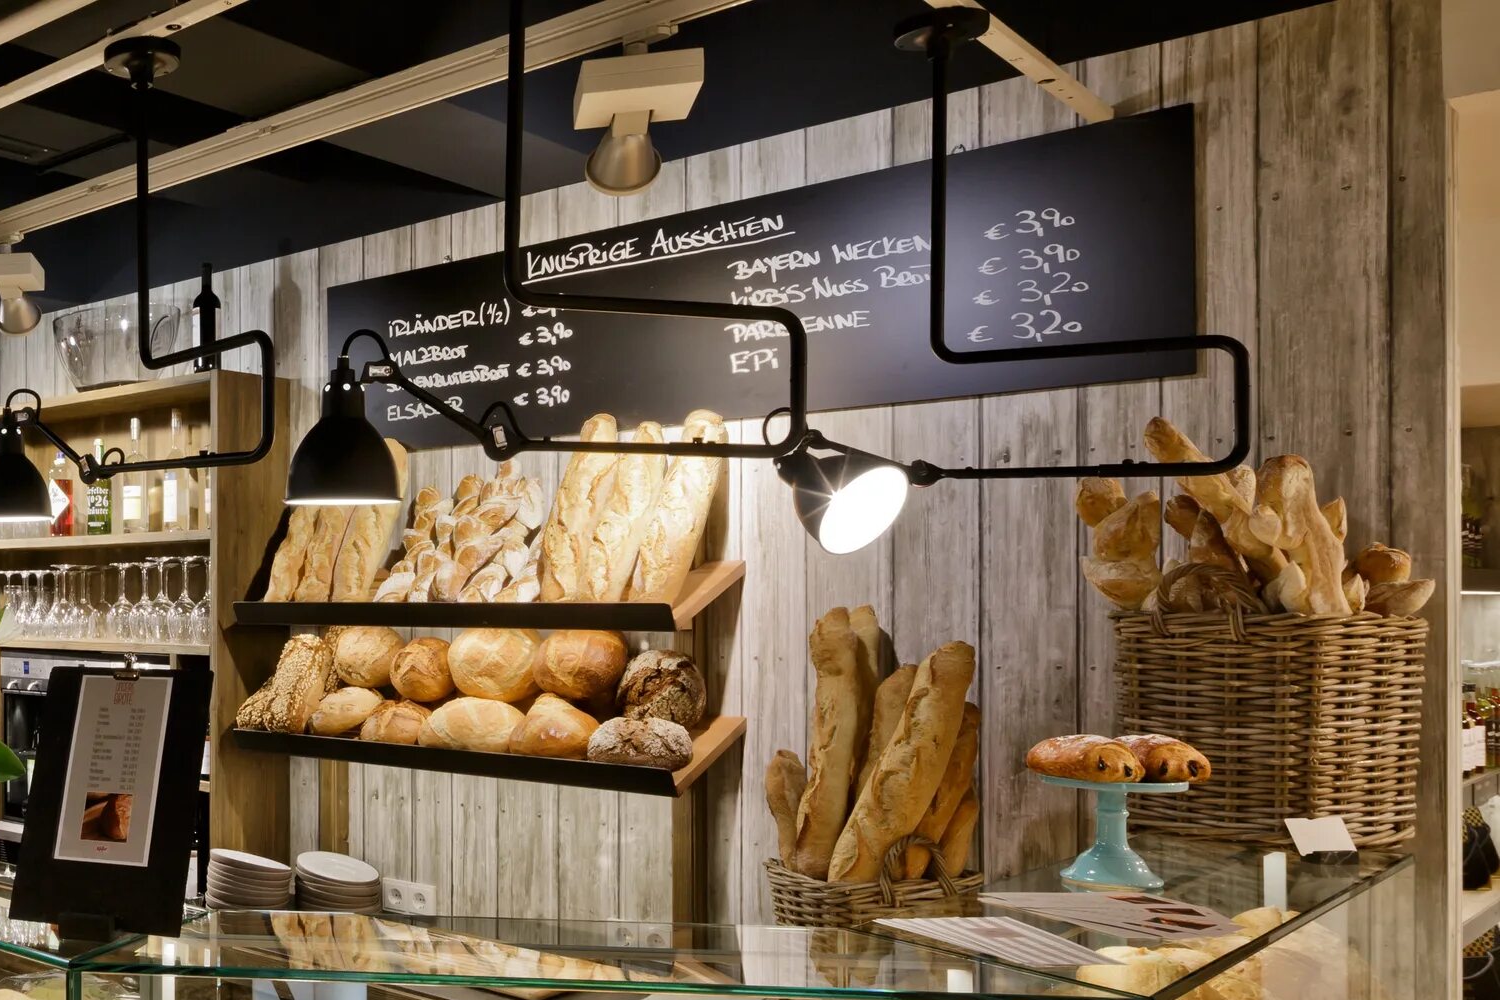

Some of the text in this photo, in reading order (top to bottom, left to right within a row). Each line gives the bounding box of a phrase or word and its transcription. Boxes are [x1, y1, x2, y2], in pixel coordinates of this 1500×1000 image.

[727, 207, 1075, 283] BAYERN WECKEN € 3,90
[978, 257, 1008, 275] €
[1018, 244, 1080, 274] 3,90
[724, 272, 1089, 343] PARISENNE € 3,20
[518, 332, 534, 346] €
[536, 322, 573, 345] 3,90
[966, 326, 994, 342] €
[1011, 309, 1083, 342] 3,20
[516, 363, 532, 376] €
[536, 356, 571, 376] 3,90
[513, 392, 529, 406] €
[536, 385, 570, 406] 3,90
